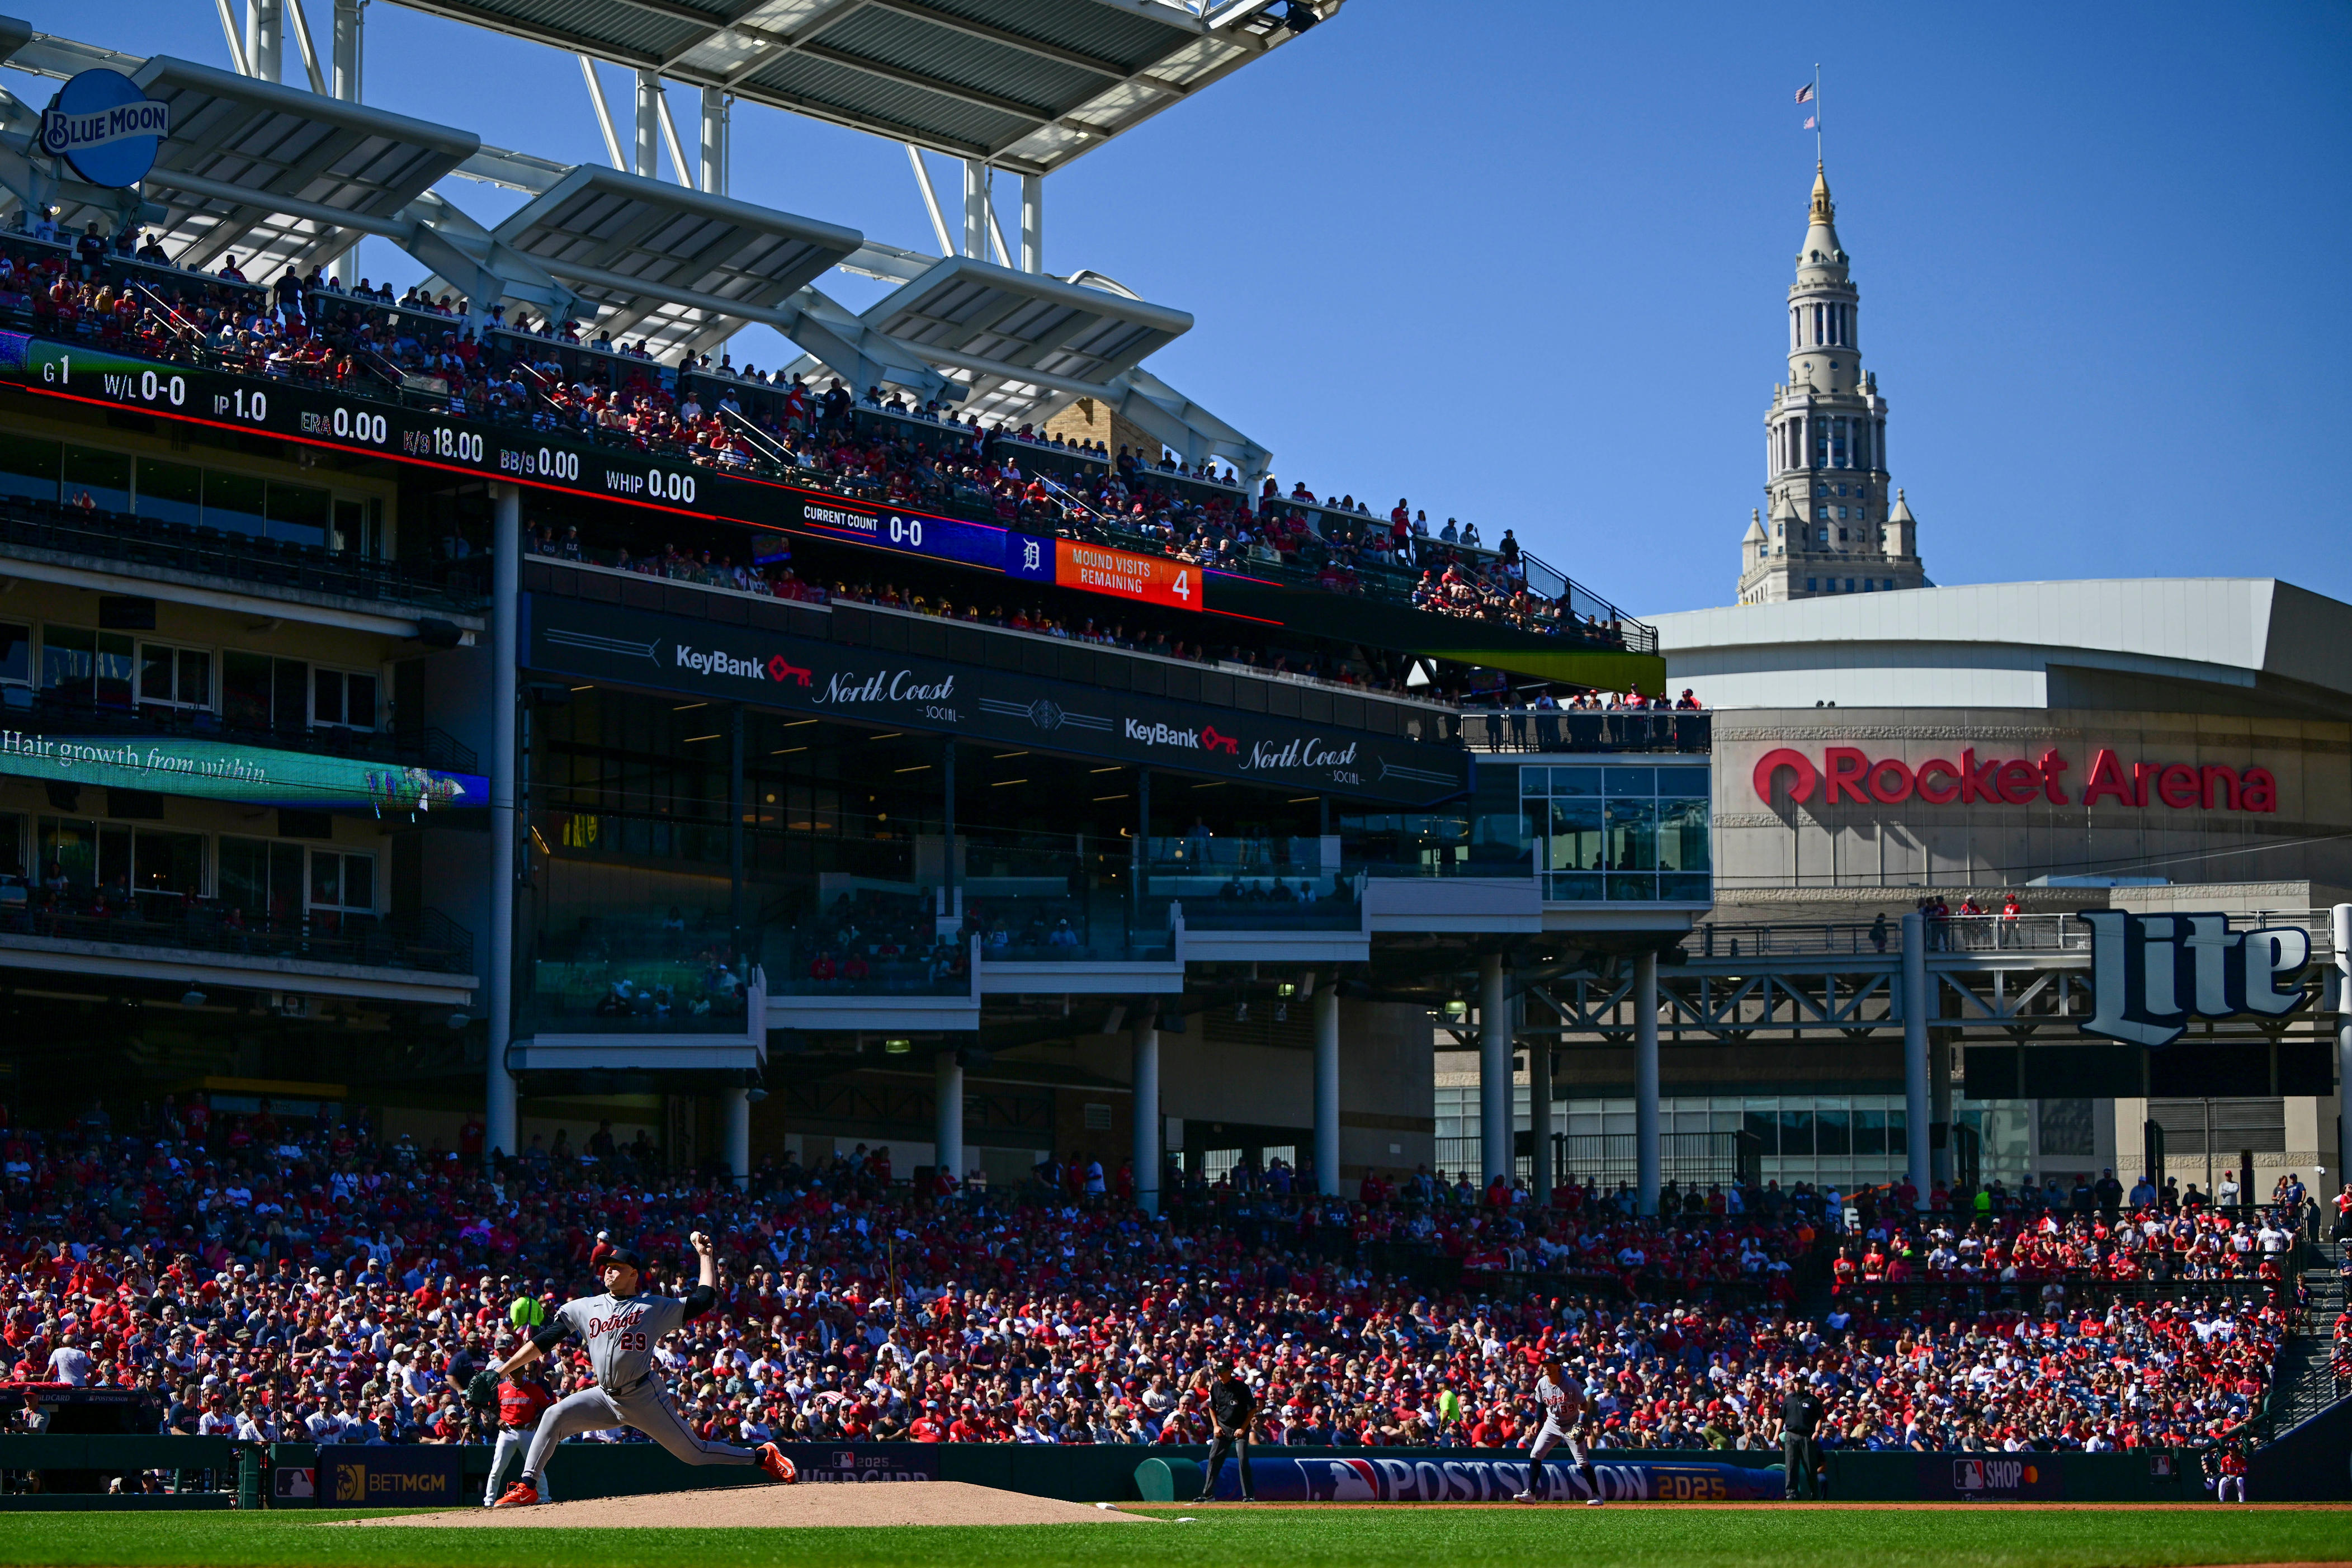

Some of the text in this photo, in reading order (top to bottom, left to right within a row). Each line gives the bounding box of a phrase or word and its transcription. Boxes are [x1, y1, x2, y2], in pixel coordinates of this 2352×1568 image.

[47, 107, 166, 149] BLUE MOON
[44, 355, 69, 384] G 1
[104, 371, 185, 406] W/L 0-0
[214, 389, 267, 421] IP 1.0
[301, 408, 386, 444] ERA 0.00
[404, 427, 483, 462] K/9 18.00
[500, 448, 579, 481] BB/9 0.00
[606, 469, 695, 503] WHIP 0.00
[804, 506, 879, 532] CURRENT COUNT
[890, 516, 922, 547] 0-0
[1073, 548, 1150, 577] MOUND VISITS
[1081, 568, 1142, 593] REMAINING
[1173, 570, 1190, 601] 4
[677, 645, 765, 680] KeyBank
[813, 670, 954, 703] North Coast
[926, 706, 957, 722] SOCIAL
[1125, 719, 1199, 749] KeyBank
[2, 730, 53, 757] Hair
[60, 745, 139, 767] growth
[141, 747, 193, 776] from
[1239, 737, 1357, 770] North Coast
[1333, 770, 1359, 785] SOCIAL
[1825, 747, 2277, 813] Rocket Arena
[2078, 910, 2310, 1047] Lite
[589, 1307, 644, 1339] Detroit
[620, 1331, 648, 1352] 29
[856, 1457, 889, 1467] 2025
[1986, 1460, 2022, 1488] SHOP
[369, 1473, 445, 1491] BETMGM
[1656, 1475, 1726, 1500] 2025
